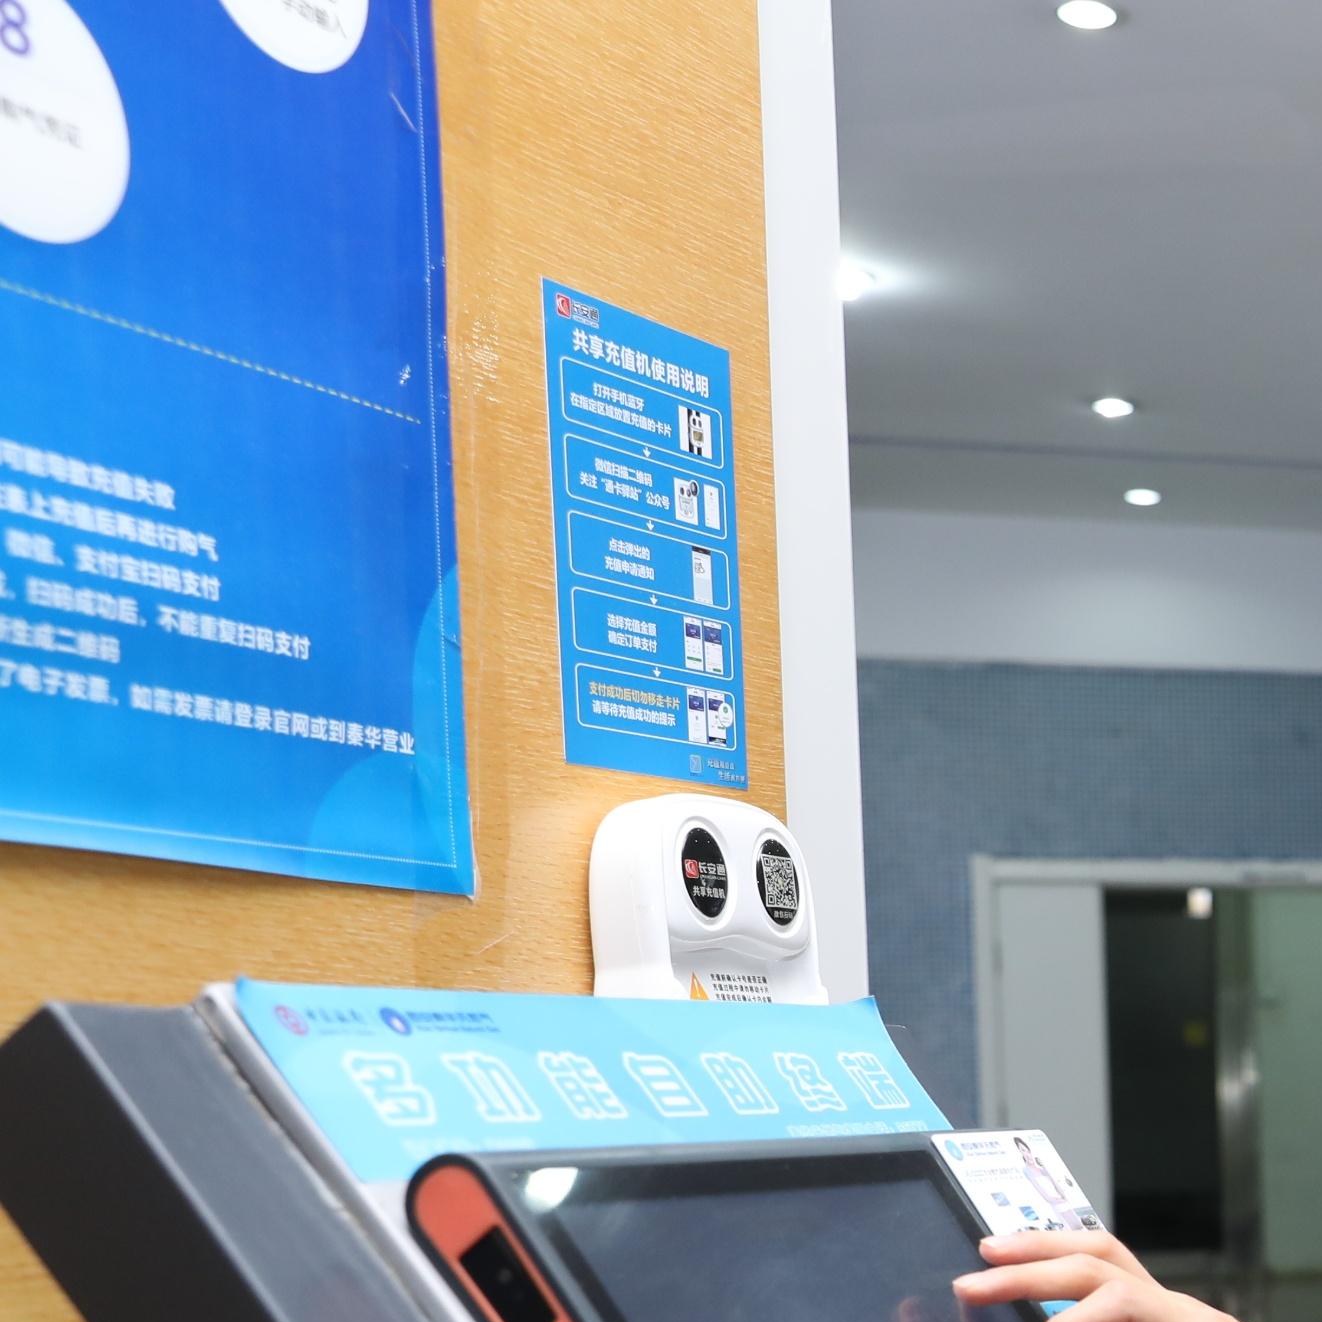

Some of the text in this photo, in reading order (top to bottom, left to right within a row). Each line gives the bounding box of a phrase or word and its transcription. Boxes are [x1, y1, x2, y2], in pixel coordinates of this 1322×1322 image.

[572, 329, 710, 399] 共享充值机使用说明
[593, 382, 645, 410] 打开手机蓝牙
[570, 392, 672, 438] 在指定区域放置充值的卡片
[594, 458, 653, 488] 微信扫描二维码
[609, 539, 651, 561] 点击弹出的
[604, 557, 655, 580] 充值申请通知
[607, 614, 657, 637] 选择充值金额
[608, 631, 658, 653] 确定订单支付
[589, 681, 681, 710] 支付成功后切勿移走卡片
[592, 700, 677, 727] 请等待充值成功的提示
[699, 861, 726, 876] 长安通
[693, 885, 726, 899] 共享充值机
[342, 1050, 911, 1126] 多功能自助终端
